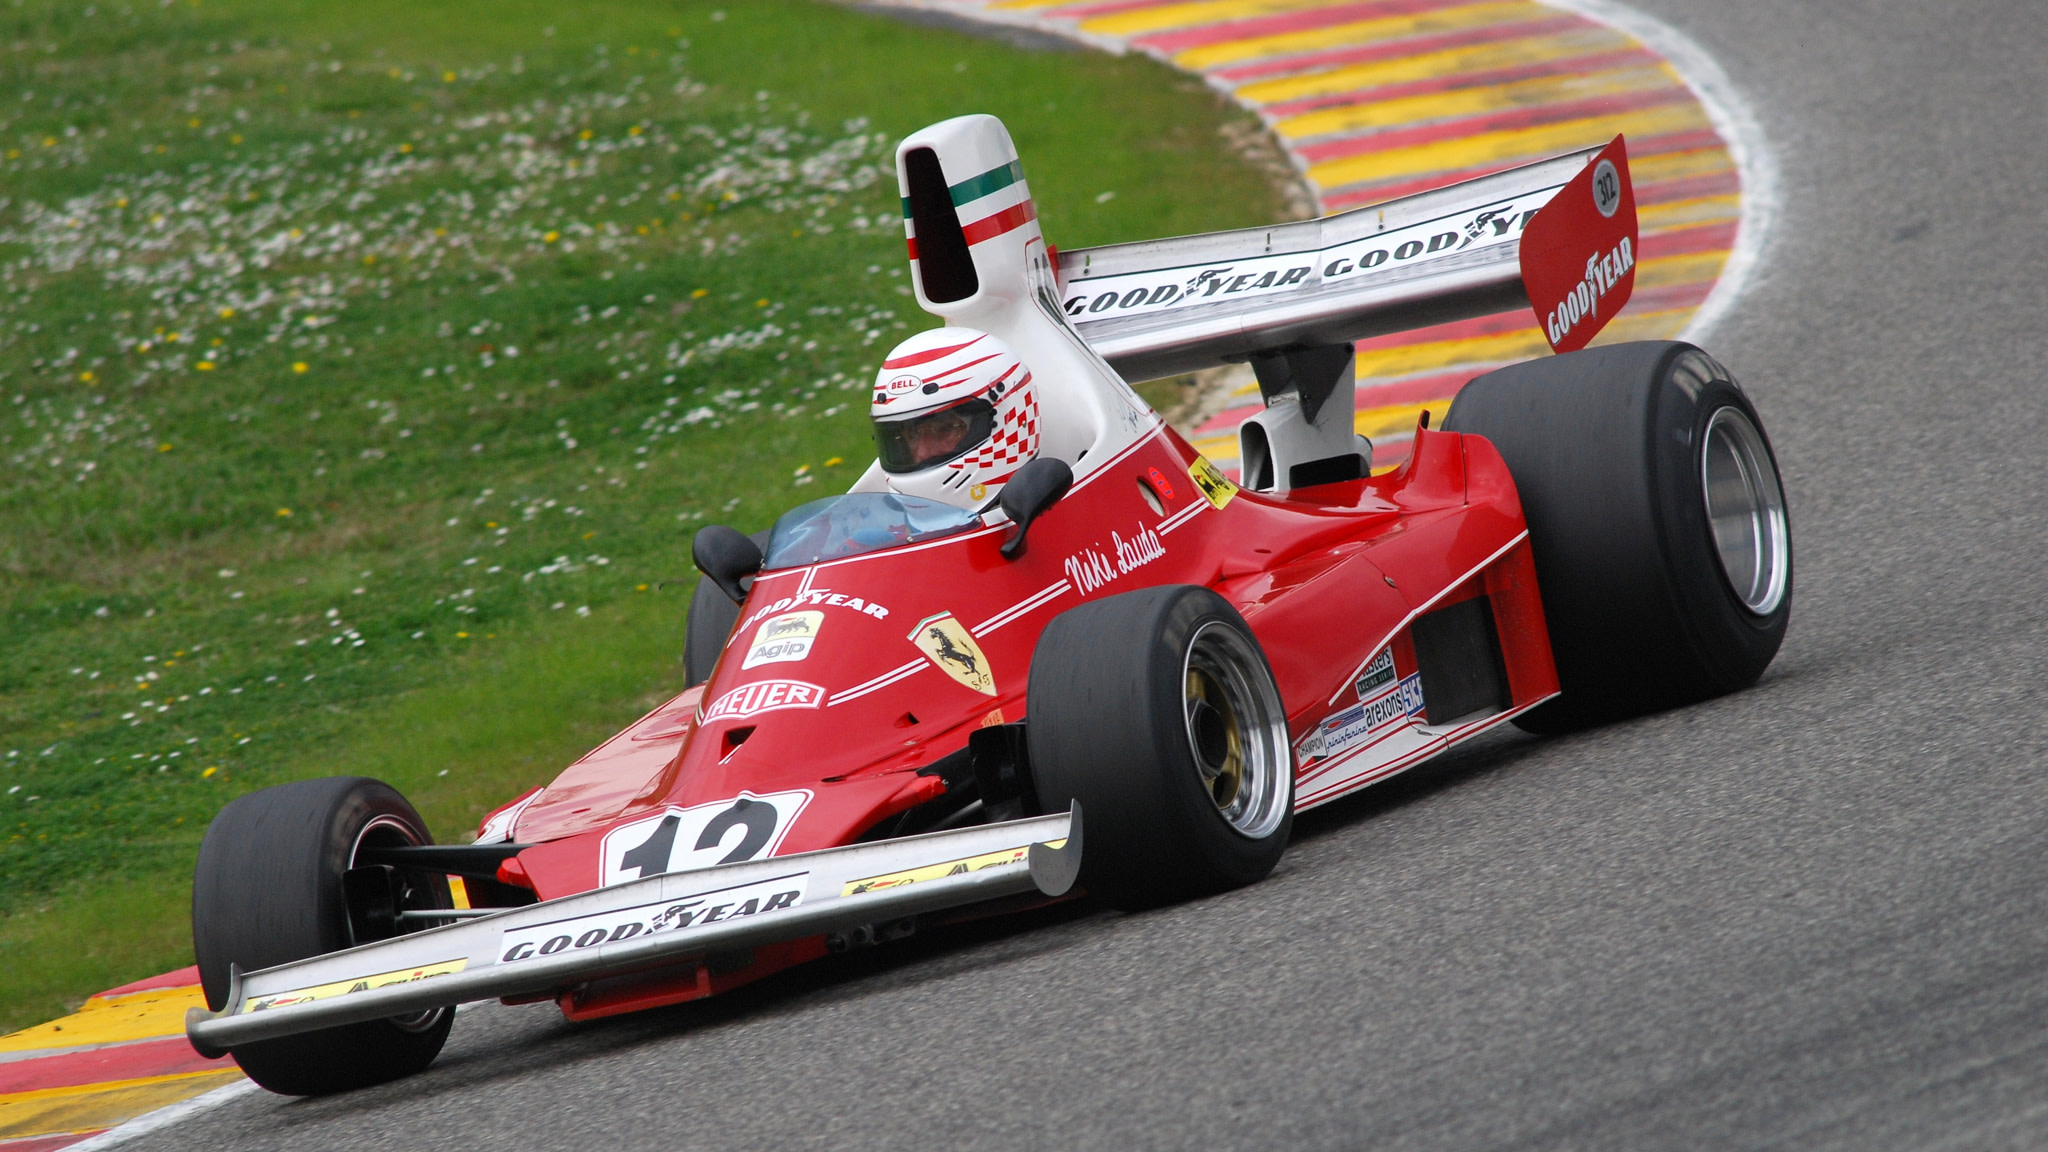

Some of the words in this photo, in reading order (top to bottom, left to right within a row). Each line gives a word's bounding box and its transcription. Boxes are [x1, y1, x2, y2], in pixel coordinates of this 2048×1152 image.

[1597, 172, 1616, 206] 312
[1547, 236, 1634, 345] GOODYEAR
[891, 379, 913, 390] BELL
[1112, 521, 1166, 574] Lauda
[751, 642, 805, 661] Agip
[711, 684, 811, 717] HEUER
[1365, 692, 1403, 727] arexons
[1298, 737, 1324, 757] CHAMPION
[620, 799, 778, 878] 12
[502, 890, 801, 962] GOODYEAR
